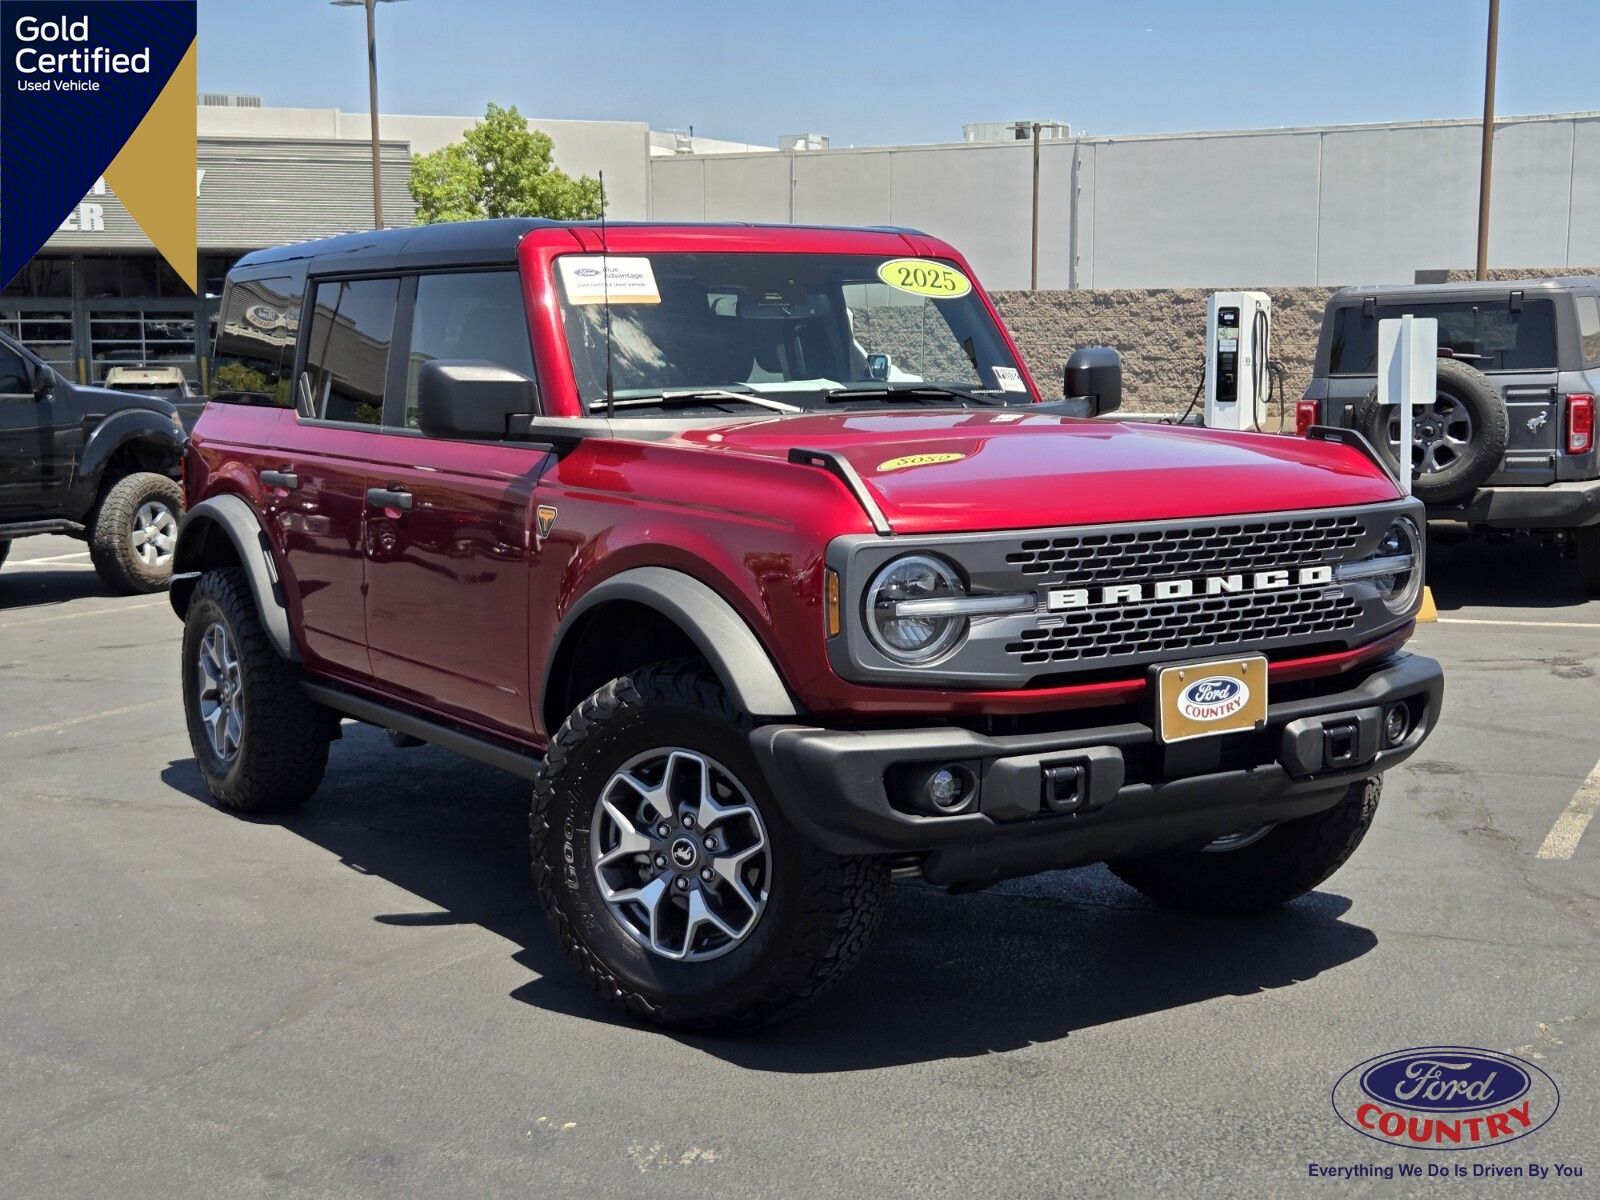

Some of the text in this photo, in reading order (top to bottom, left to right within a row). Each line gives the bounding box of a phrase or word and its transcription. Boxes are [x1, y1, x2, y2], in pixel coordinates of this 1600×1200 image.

[898, 267, 956, 292] 2025
[1048, 565, 1332, 610] BRONCO
[1197, 681, 1231, 704] Ford
[1185, 696, 1241, 718] COUNTRY
